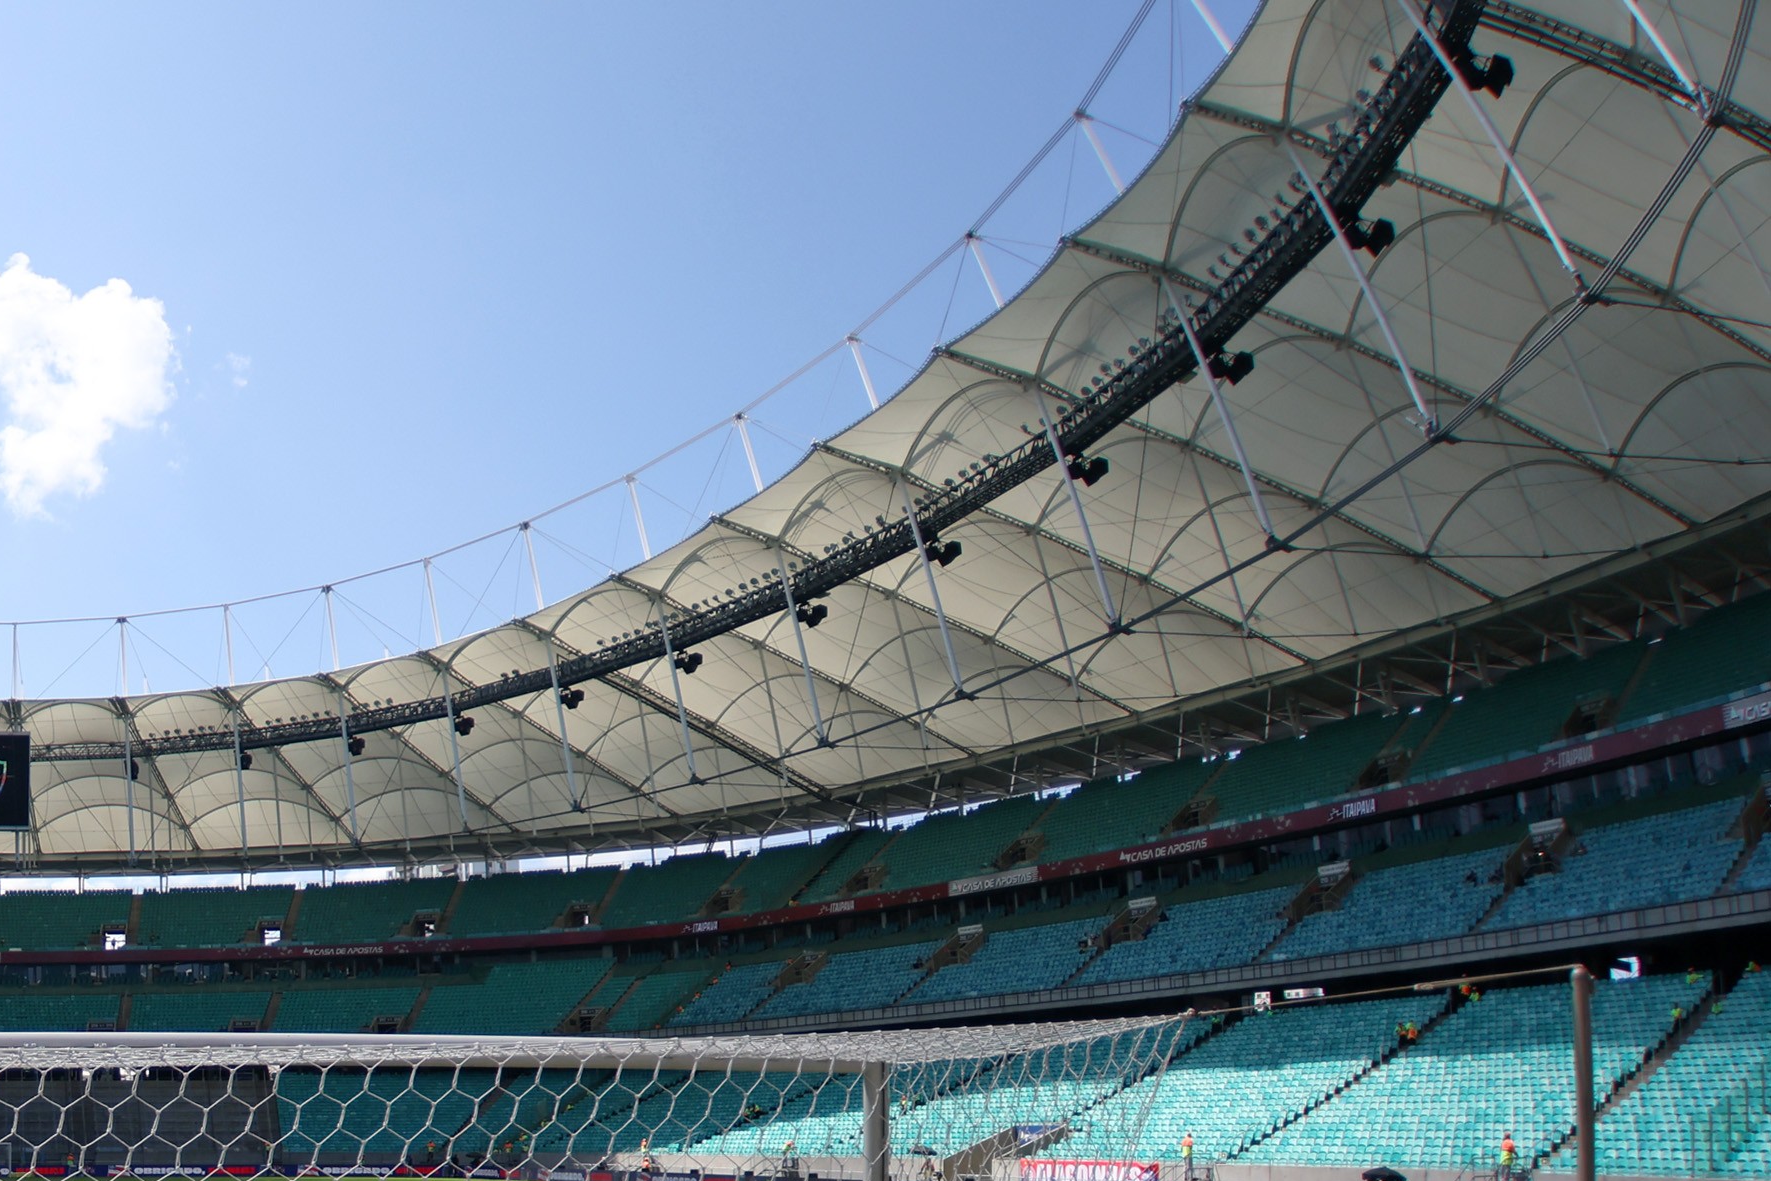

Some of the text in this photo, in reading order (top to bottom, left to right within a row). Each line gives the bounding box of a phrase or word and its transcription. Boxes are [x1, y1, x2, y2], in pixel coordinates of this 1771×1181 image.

[1342, 798, 1375, 819] ITAIPAVA
[1130, 837, 1208, 863] CASA DE APOSTAS
[961, 872, 1034, 894] CASA DE APOSTAS
[829, 899, 855, 913] ITAIPAVA
[692, 920, 718, 934] ITAIPAVA
[314, 946, 384, 956] CASA DE APOSTAS
